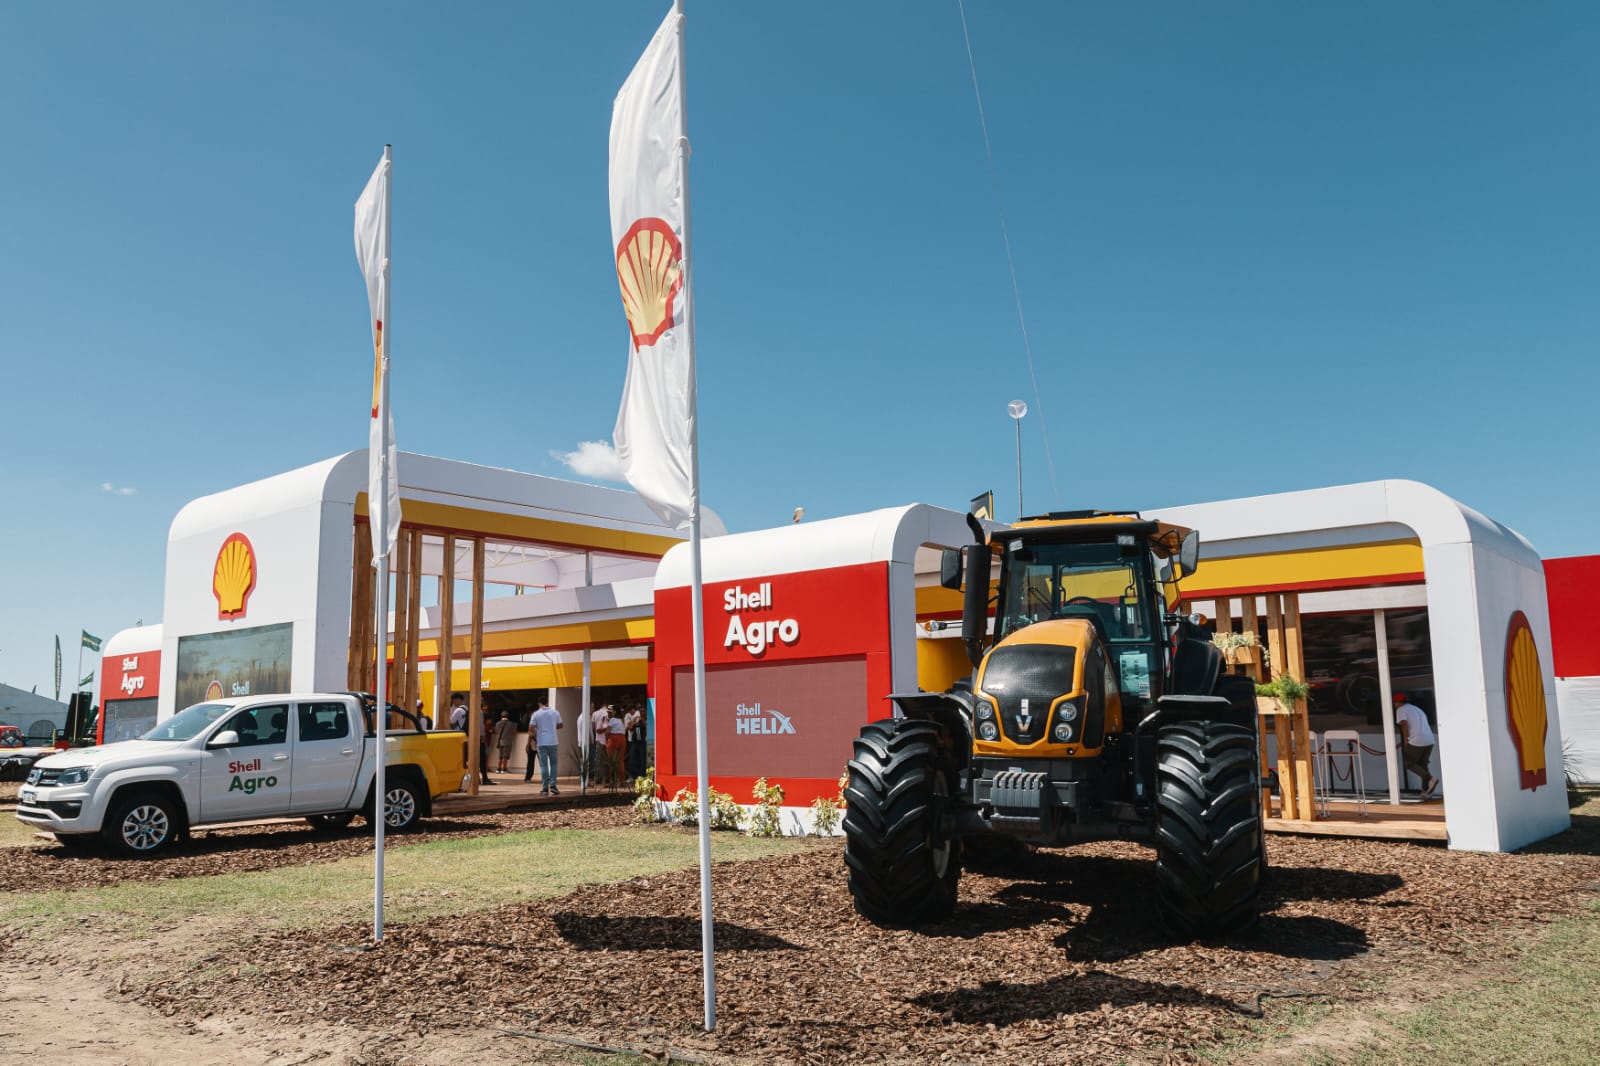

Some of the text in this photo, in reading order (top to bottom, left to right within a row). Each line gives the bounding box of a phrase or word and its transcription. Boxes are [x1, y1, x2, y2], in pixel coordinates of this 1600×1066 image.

[724, 582, 772, 611] Shell
[723, 615, 799, 655] Agro
[122, 656, 138, 671] Shell
[121, 673, 144, 695] Agro
[232, 680, 250, 695] Shell
[736, 703, 761, 717] Shell
[736, 712, 796, 735] HELIX
[228, 758, 261, 774] Shell
[228, 775, 278, 795] Agro
